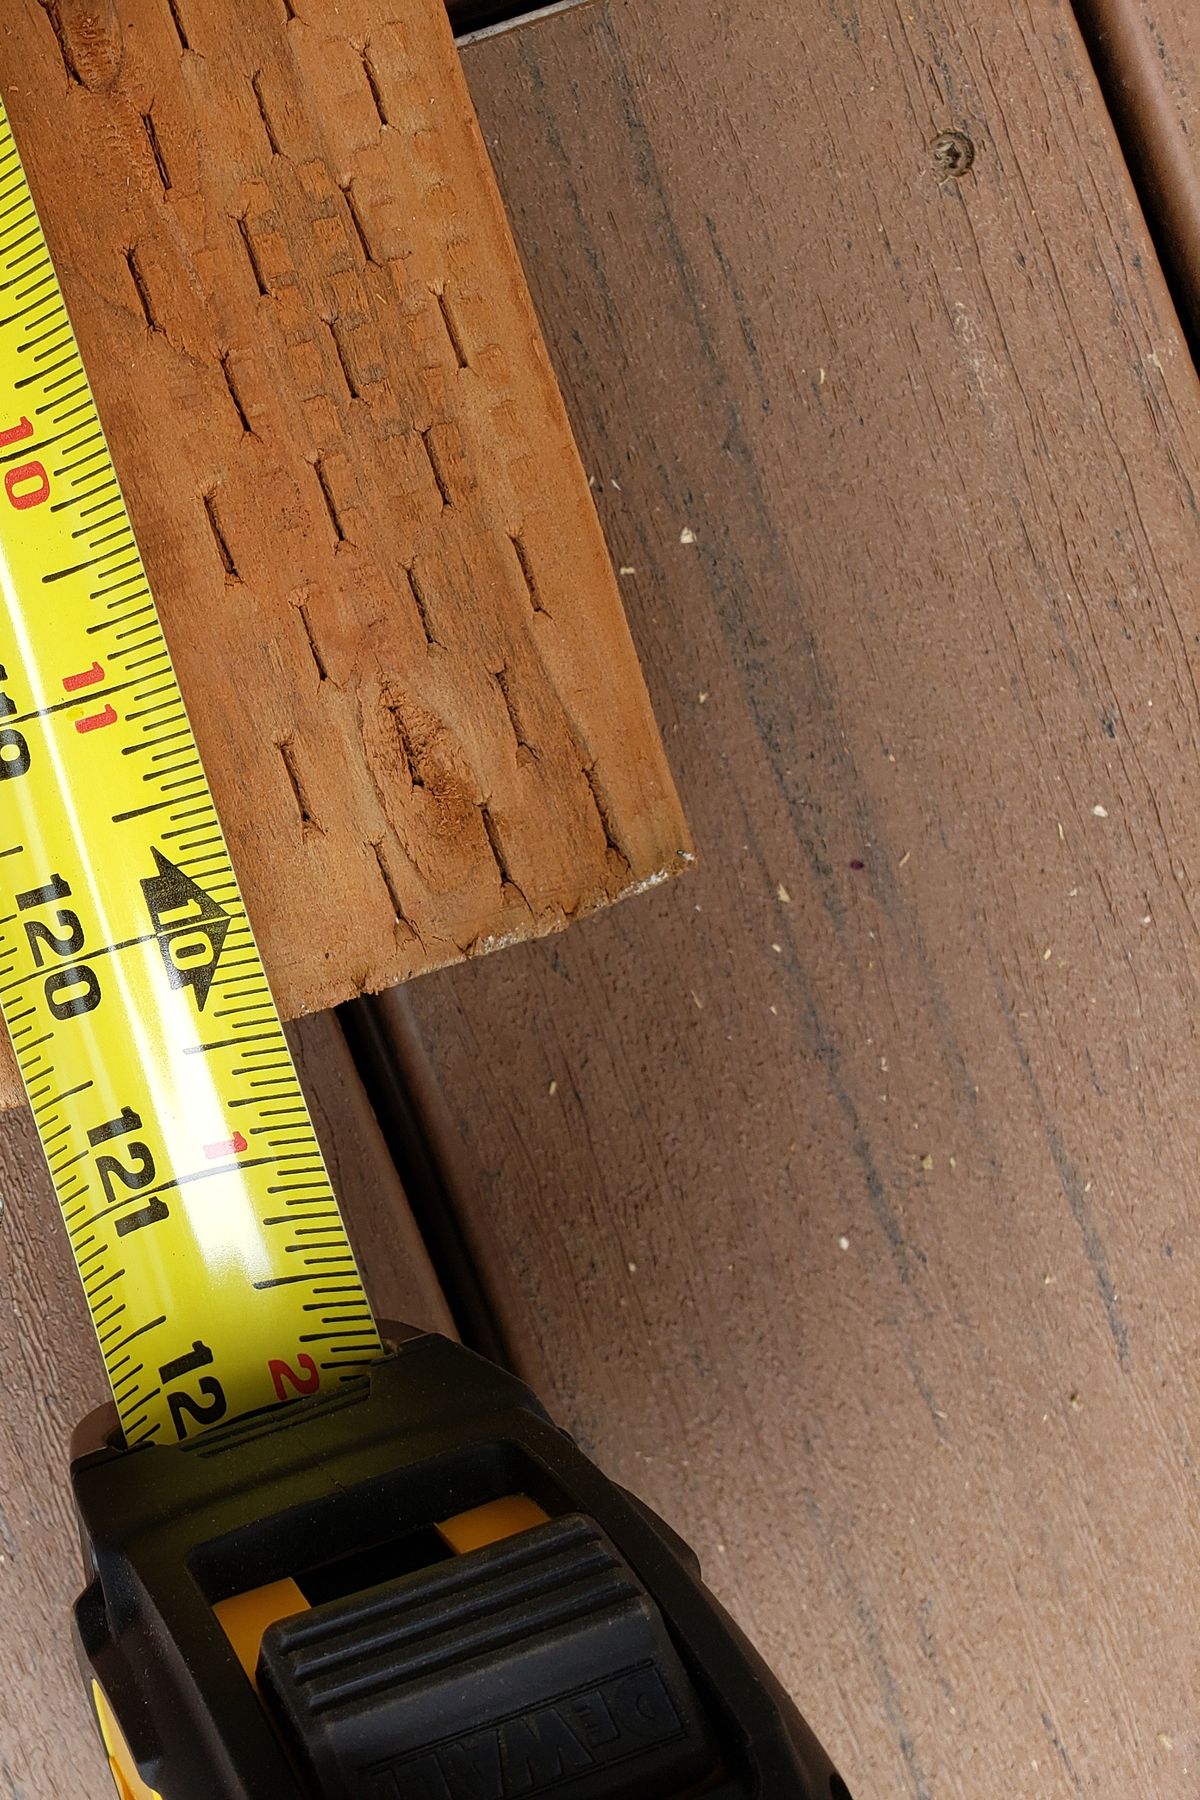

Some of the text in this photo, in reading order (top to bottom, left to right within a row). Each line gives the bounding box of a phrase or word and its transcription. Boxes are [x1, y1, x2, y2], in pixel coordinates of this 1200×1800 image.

[62, 661, 118, 734] 11
[15, 873, 102, 1021] 120
[154, 897, 216, 972] 10
[86, 1105, 170, 1238] 121
[202, 1130, 249, 1161] 1
[267, 1353, 321, 1401] 2
